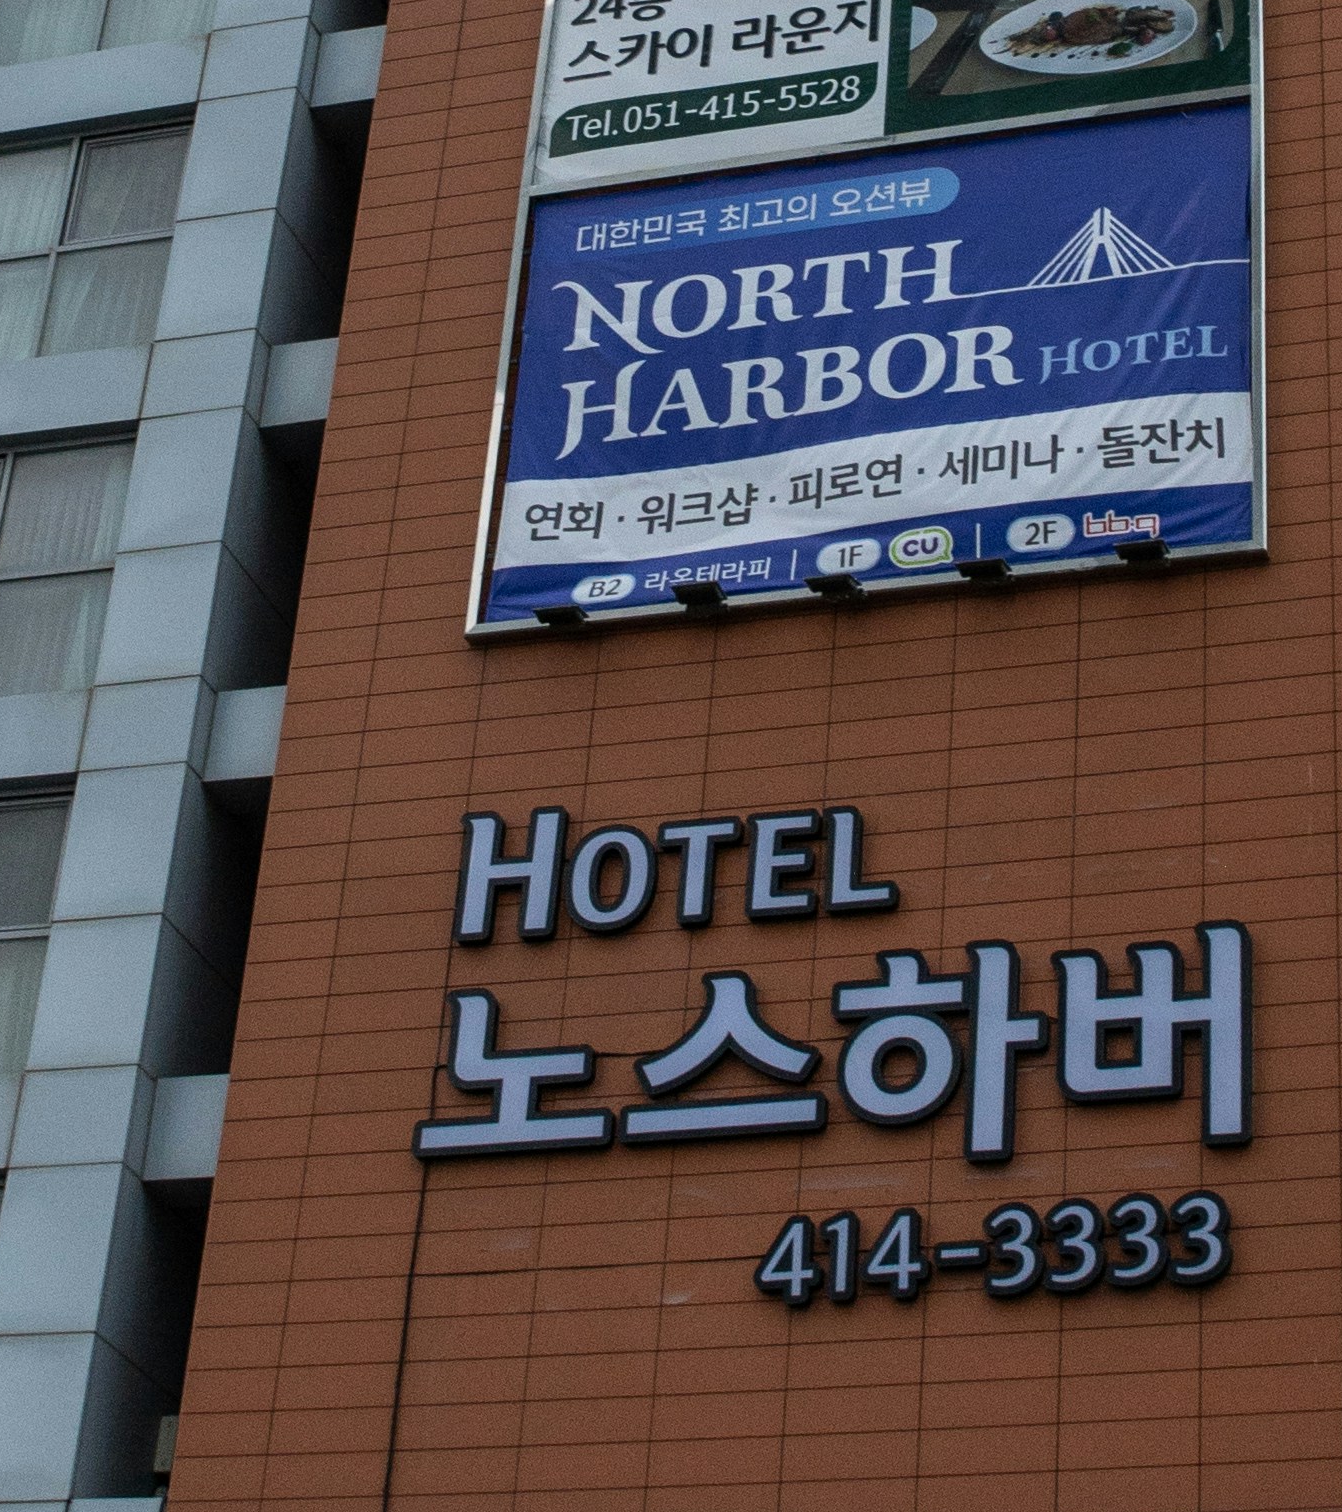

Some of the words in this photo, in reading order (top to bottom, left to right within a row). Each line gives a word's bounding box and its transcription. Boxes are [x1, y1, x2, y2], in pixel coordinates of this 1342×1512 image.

[563, 25, 713, 82] 스카이
[577, 208, 708, 252] 대한민국
[716, 193, 817, 235] 최고의
[829, 176, 933, 220] 오션뷰
[552, 239, 967, 354] NORTH
[555, 325, 1026, 460] HARBOR
[1038, 325, 1229, 384] HOTEL
[524, 501, 605, 544] 연회
[637, 487, 758, 537] 워크샵
[788, 453, 903, 510] 피로연
[939, 434, 1064, 488] 세미나
[1097, 416, 1226, 470] 돌잔치
[589, 578, 622, 598] B2
[837, 545, 863, 568] 1F
[902, 537, 940, 558] CU
[1025, 522, 1058, 546] 2F
[456, 806, 900, 944] HOTEL
[414, 920, 1253, 1162] 노스하버
[754, 1190, 1232, 1306] 414-3333
